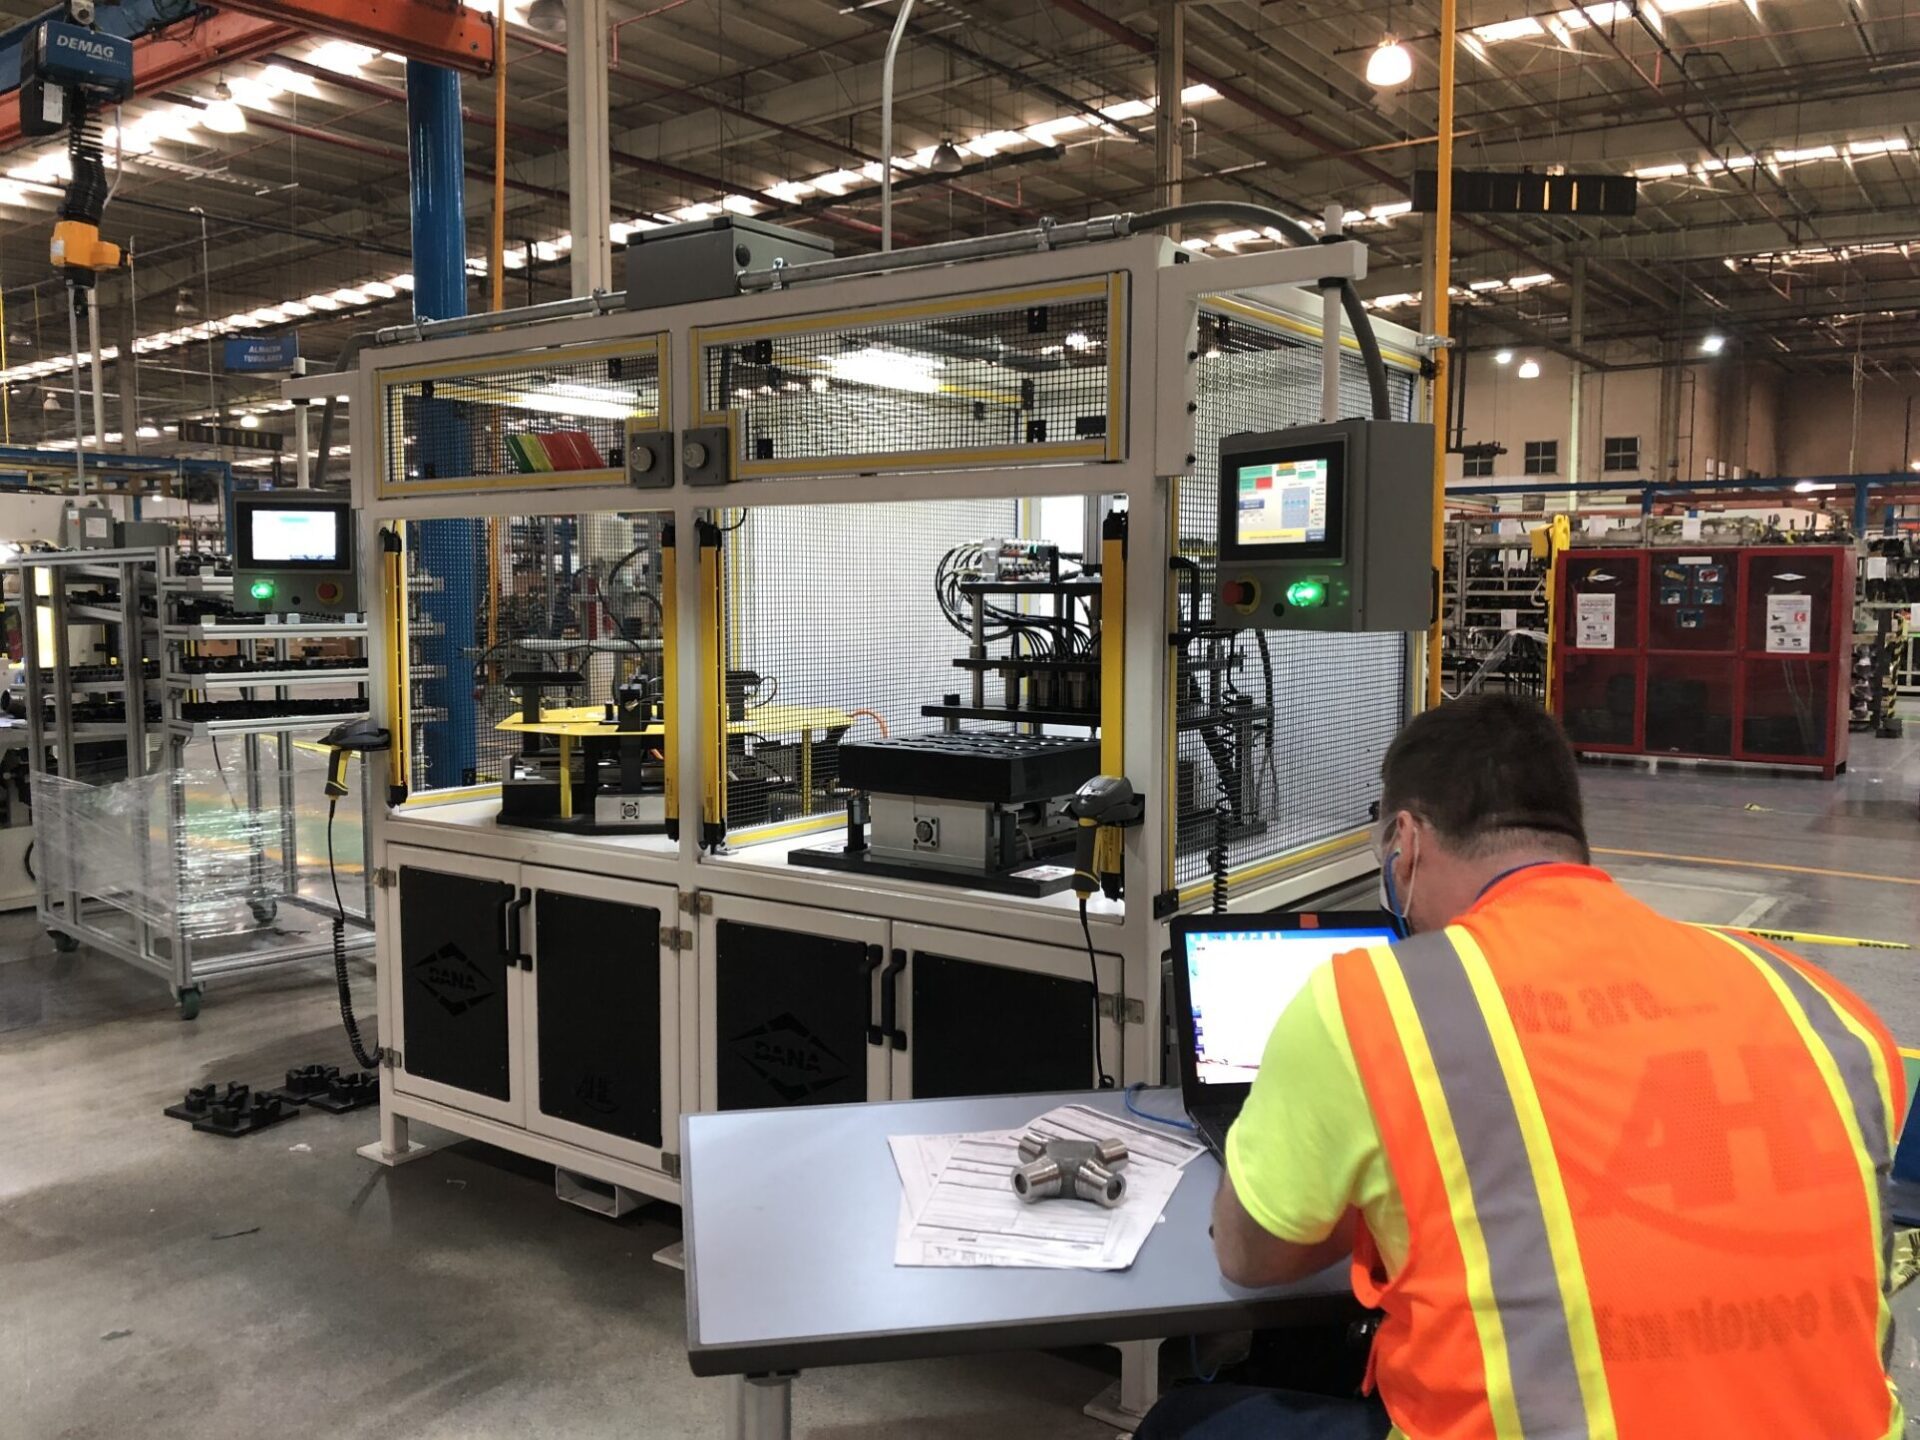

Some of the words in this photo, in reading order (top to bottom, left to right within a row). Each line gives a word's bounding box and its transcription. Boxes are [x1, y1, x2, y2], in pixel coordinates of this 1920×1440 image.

[56, 34, 116, 58] DEMAG
[428, 965, 478, 992] DANA
[755, 1040, 823, 1074] DANA
